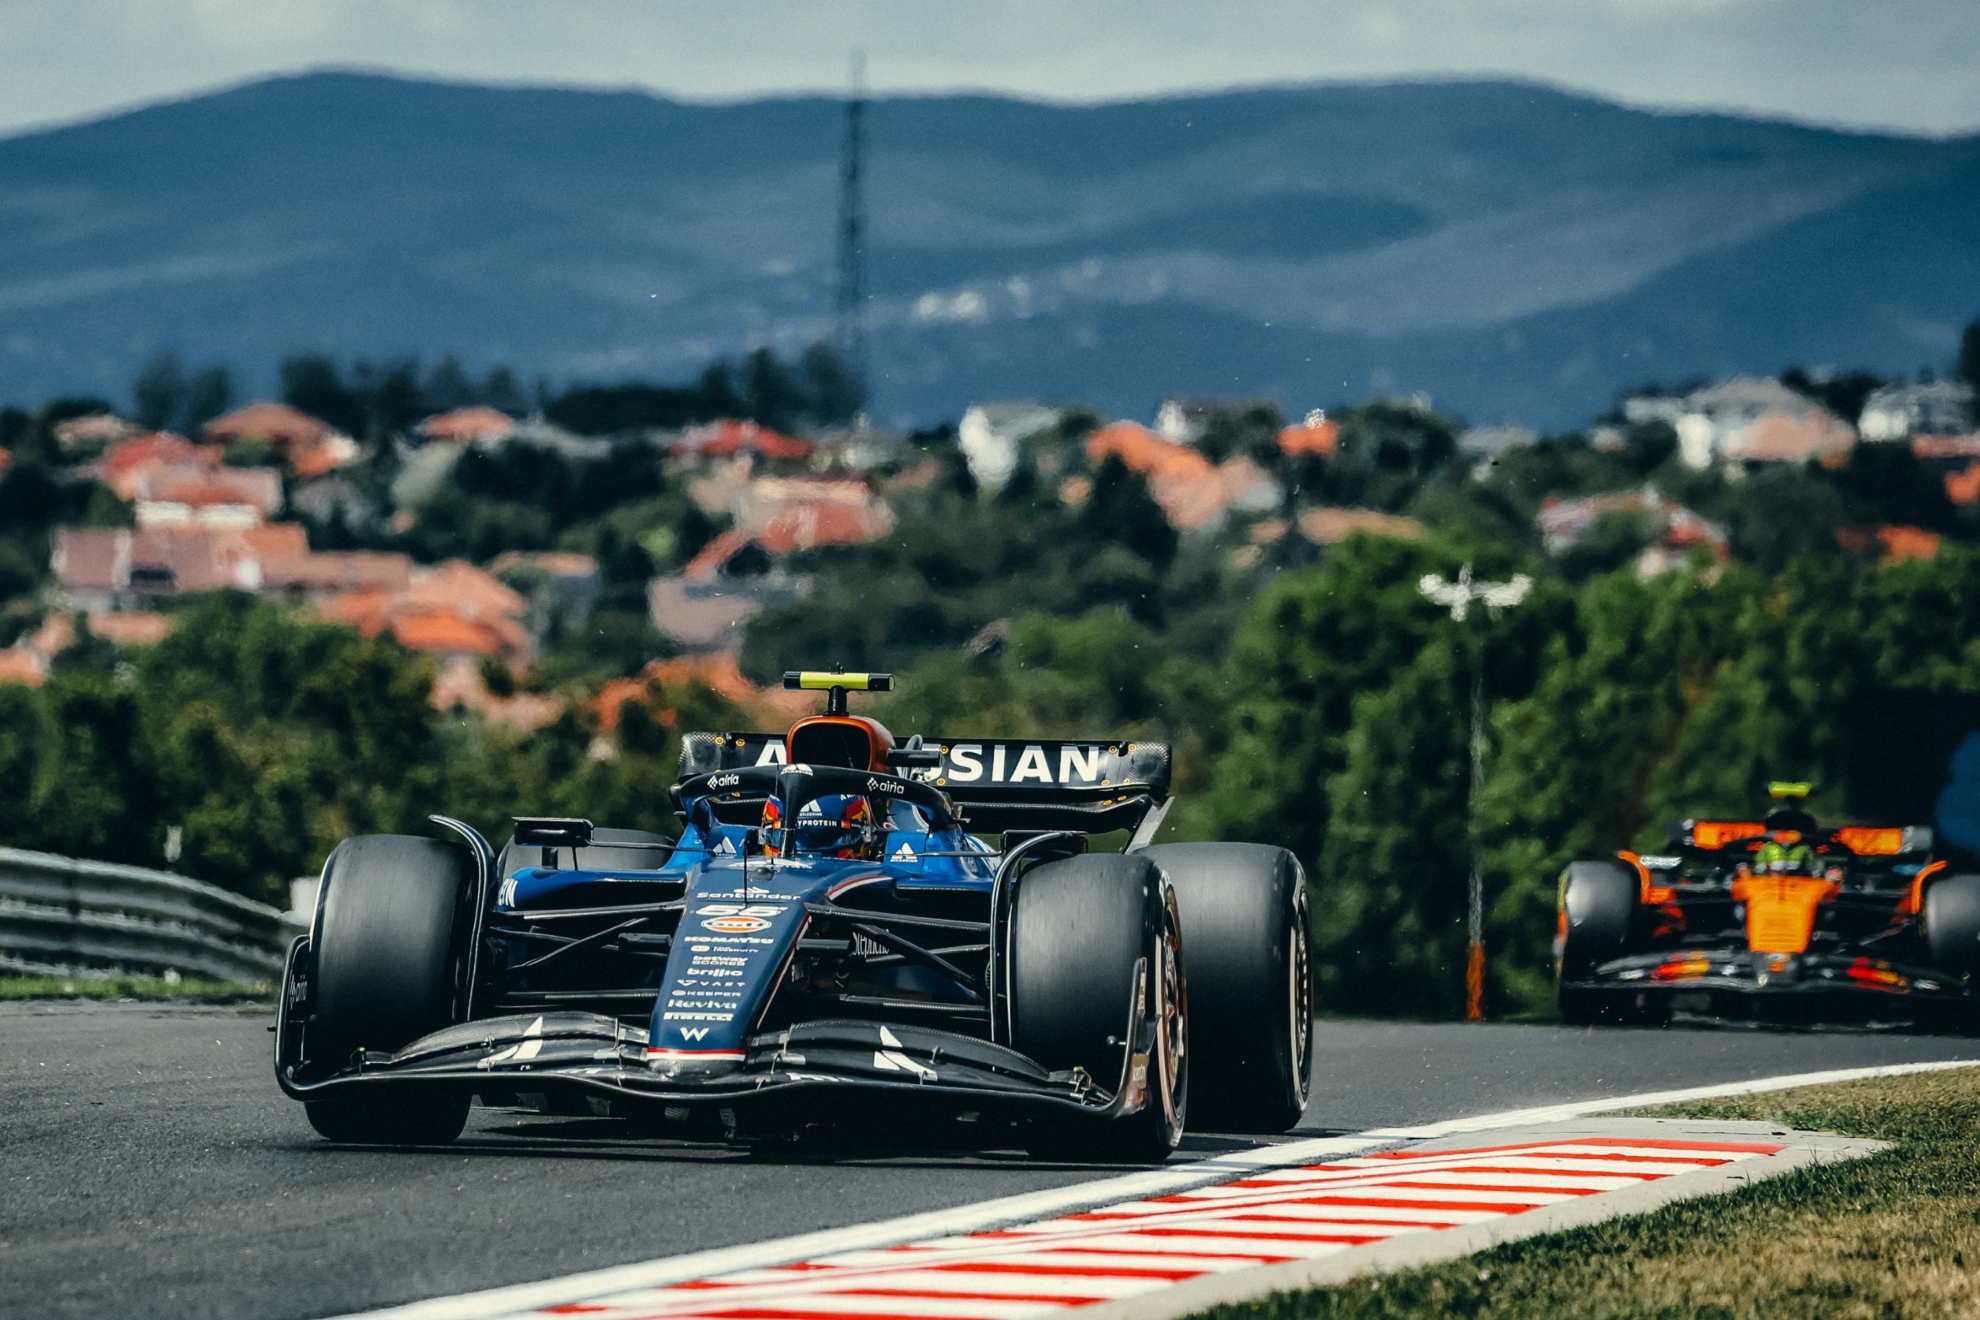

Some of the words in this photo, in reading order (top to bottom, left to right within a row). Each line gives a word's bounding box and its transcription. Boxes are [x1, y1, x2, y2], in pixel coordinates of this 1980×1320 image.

[719, 774, 739, 787] airia
[879, 780, 905, 795] airia
[696, 891, 801, 900] Santander
[695, 904, 788, 917] 55
[684, 936, 774, 945] KOMATSU
[667, 999, 737, 1010] Reviva
[663, 1012, 734, 1022] PIRELLI
